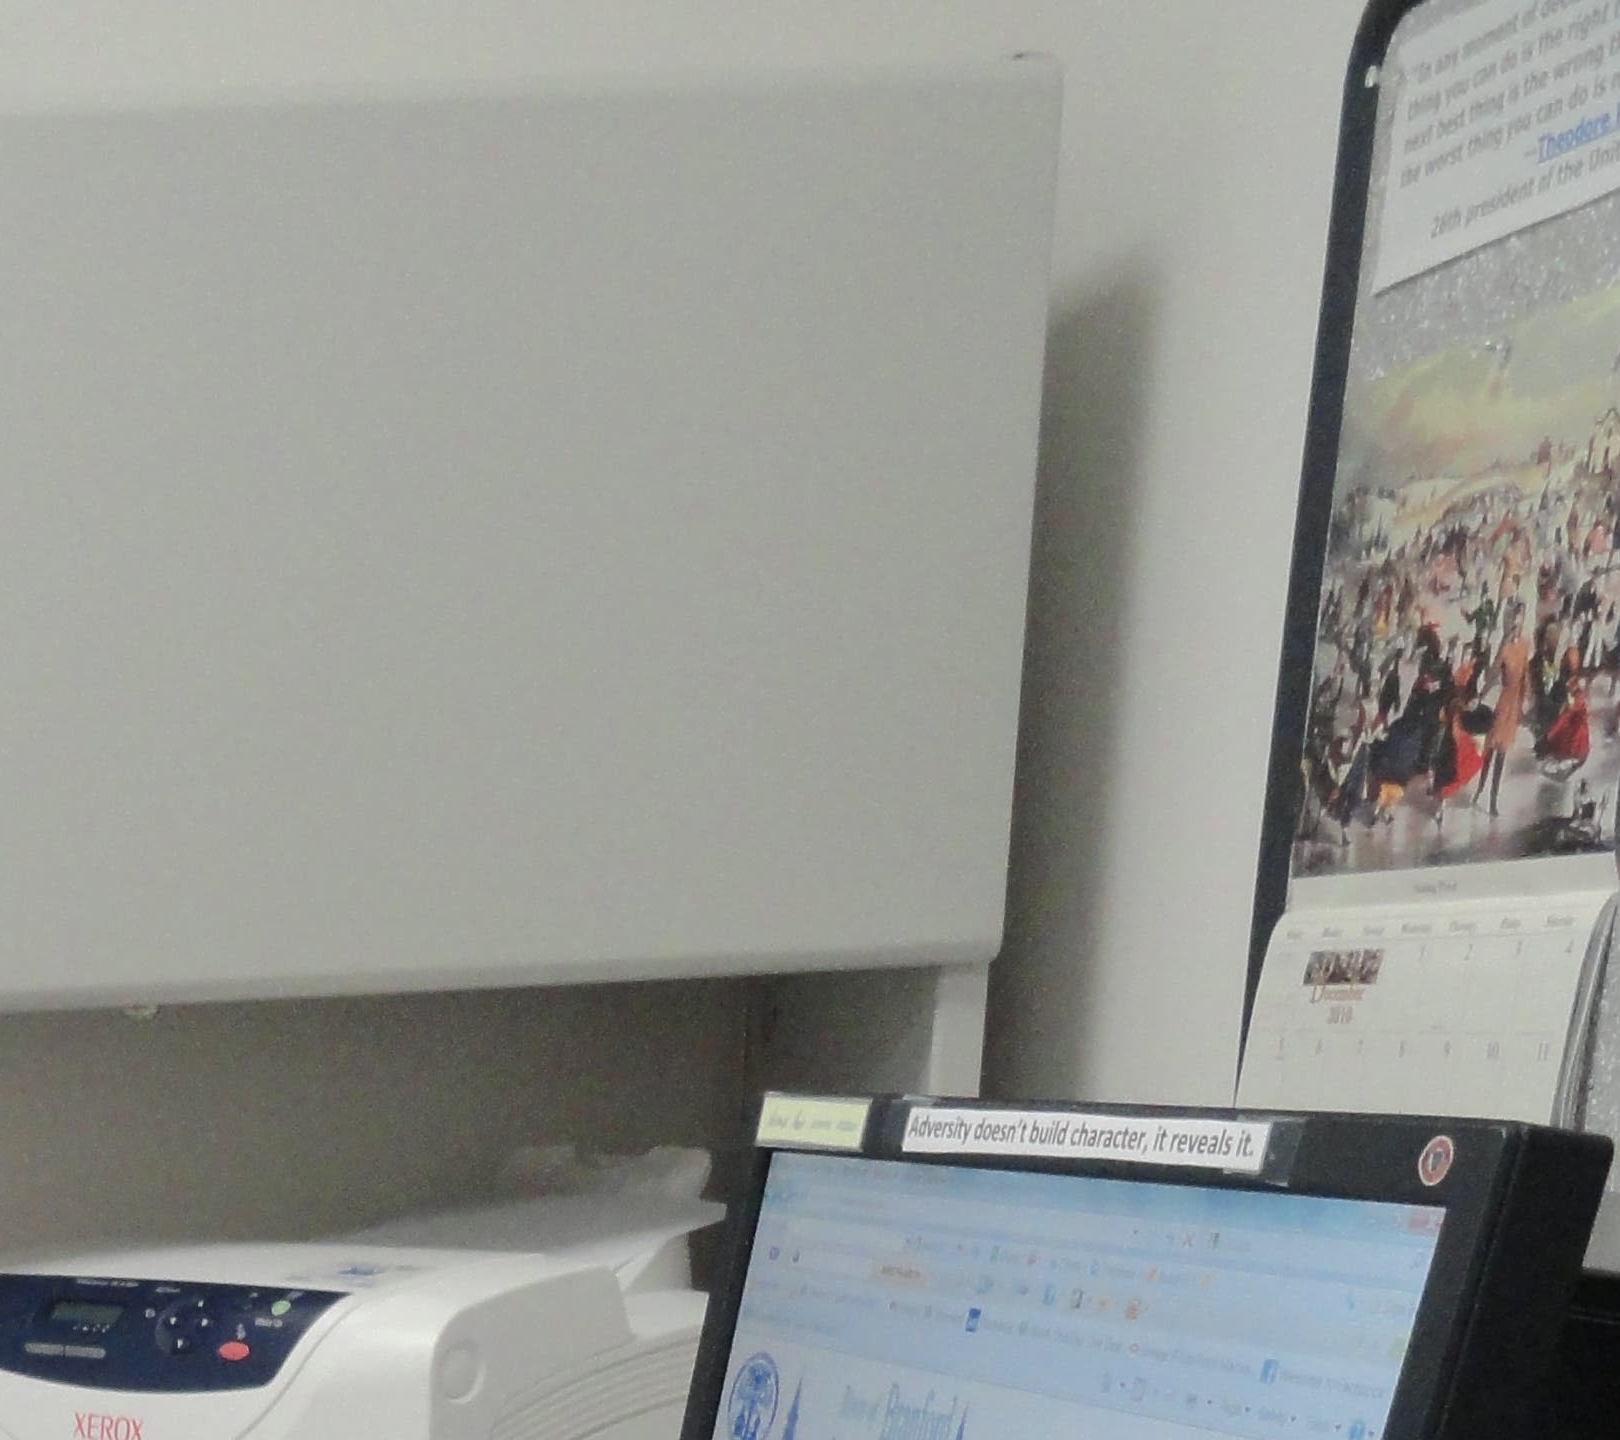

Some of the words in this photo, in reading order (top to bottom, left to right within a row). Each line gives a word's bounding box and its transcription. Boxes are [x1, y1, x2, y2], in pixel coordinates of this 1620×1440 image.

[1500, 48, 1517, 75] do
[1537, 26, 1563, 56] the
[1567, 3, 1609, 42] right
[1523, 70, 1548, 98] the
[1553, 44, 1604, 82] wrong
[1506, 113, 1532, 146] you
[1536, 98, 1563, 124] can
[1567, 82, 1589, 111] do
[1592, 72, 1607, 100] is
[1463, 176, 1535, 230] president
[1538, 166, 1555, 193] of
[1558, 158, 1585, 185] the
[909, 1115, 972, 1145] Adversity
[974, 1119, 1027, 1143] doesn't
[1029, 1120, 1069, 1145] build
[1070, 1122, 1147, 1154] character,
[1153, 1126, 1168, 1152] it
[1169, 1129, 1232, 1156] reveals
[1236, 1130, 1254, 1157] it.
